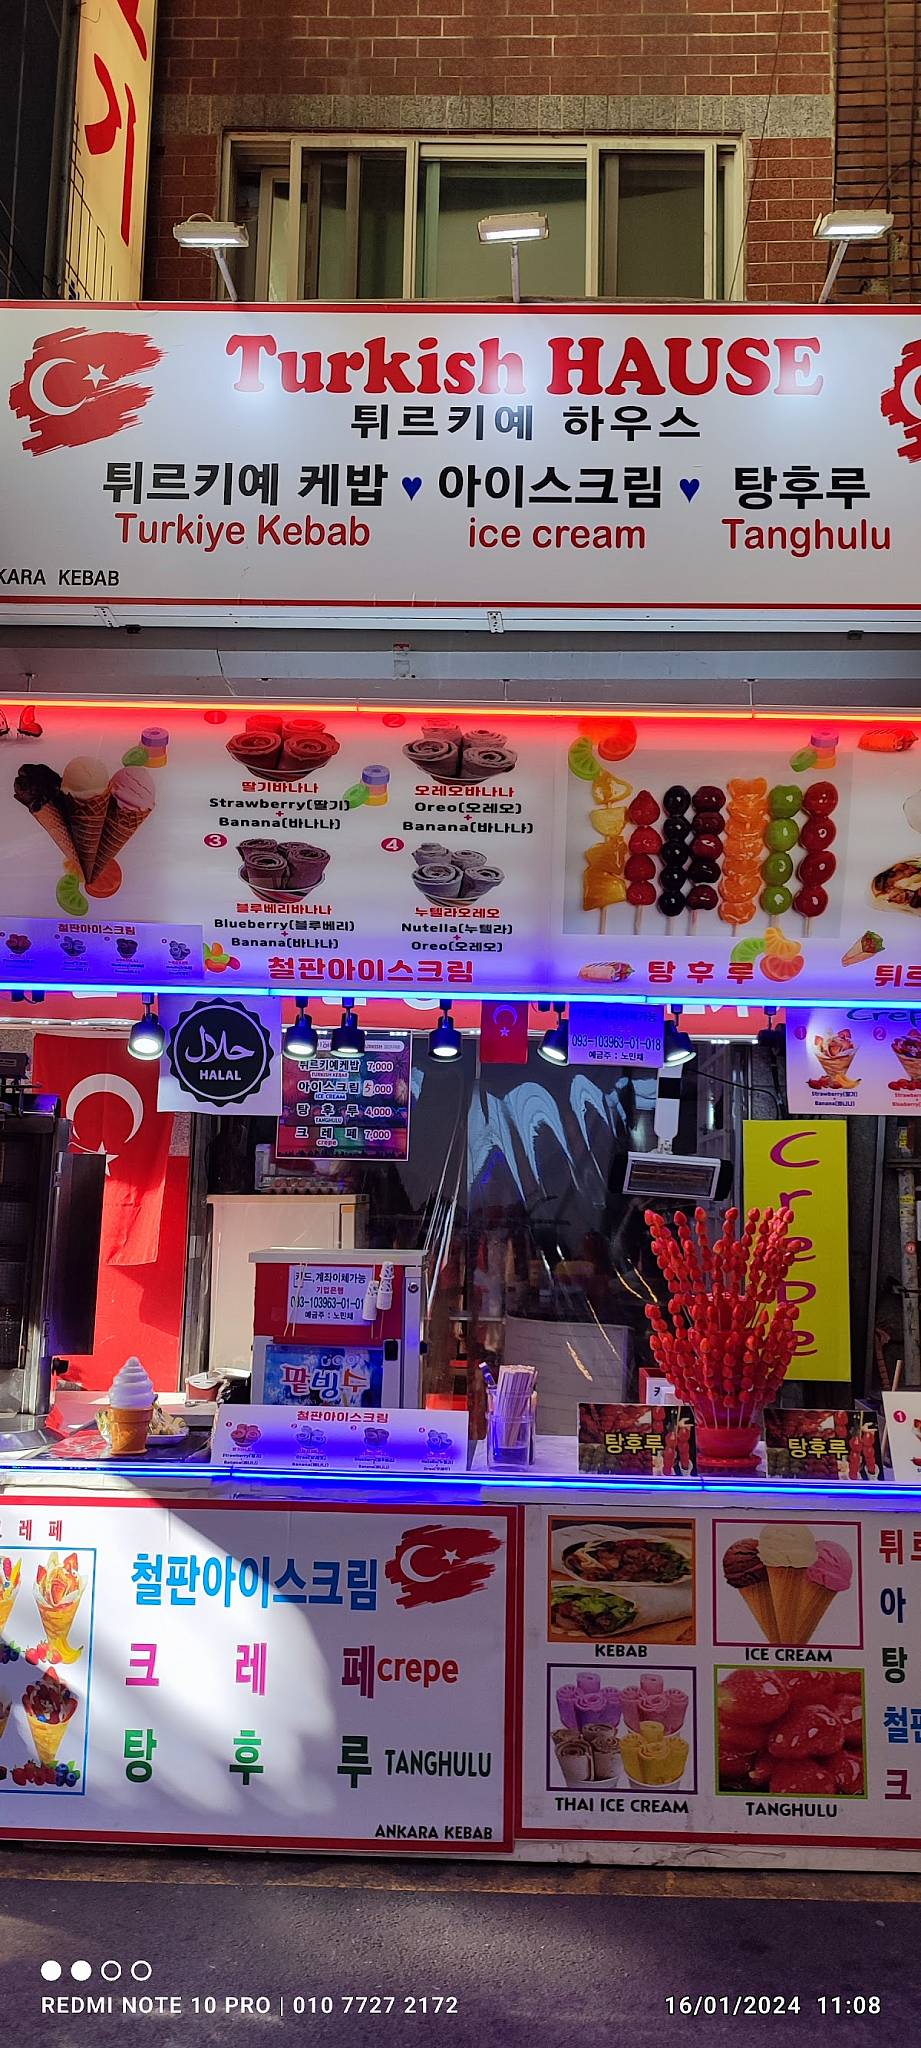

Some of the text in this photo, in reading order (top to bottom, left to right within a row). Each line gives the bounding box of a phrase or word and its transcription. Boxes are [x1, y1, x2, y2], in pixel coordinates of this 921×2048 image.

[226, 334, 824, 397] Turkish HAUSE
[351, 404, 701, 442] 튀르키예 하우스
[103, 462, 870, 510] 튀르키예 케밥 아이스크림 탕후루
[115, 512, 371, 553] Turkiye Kebab
[468, 517, 646, 549] ice cream
[721, 518, 891, 558] Tanghulu
[58, 569, 120, 586] KEBAB
[242, 781, 319, 793] 딸기바나나
[415, 785, 515, 797] 오레오바나나
[209, 798, 350, 811] Strawberry(딸기)
[415, 802, 522, 814] Oreo(오레오)
[219, 817, 341, 830] Banana(바나나)
[403, 821, 534, 834] Banana(바나나)
[236, 903, 332, 915] 블루베리바나나
[415, 907, 500, 919] 누텔라오레오
[58, 923, 136, 936] 철판아이스크림
[214, 919, 355, 931] Blueberry(블루베리)
[401, 923, 513, 935] Nutella(누텔라)
[231, 938, 339, 949] Banana(바나나)
[411, 941, 503, 952] Oreo(오레오)
[268, 956, 473, 983] 철판아이스크림
[184, 1025, 255, 1063] حلال
[571, 1033, 661, 1051] 093-103963-01-018
[199, 1069, 242, 1081] HALAL
[366, 1062, 393, 1073] 7,000
[299, 1081, 360, 1093] 아이스크림
[364, 1107, 391, 1117] 4,000
[364, 1130, 390, 1140] 7,000
[281, 1364, 368, 1399] 팥빙수
[297, 1410, 389, 1424] 철판아이스크림
[604, 1433, 665, 1454] 탕후루
[787, 1437, 849, 1459] 탕후루
[131, 1553, 378, 1611] 철판아이스크림
[594, 1643, 648, 1658] KEBAB
[745, 1647, 833, 1663] ICE CREAM
[377, 1657, 459, 1688] crepe
[385, 1749, 492, 1778] TANGHULU
[554, 1797, 689, 1814] THAI ICE CREAM
[745, 1801, 838, 1817] TANGHULU
[374, 1823, 493, 1840] ANKARA KEBAB
